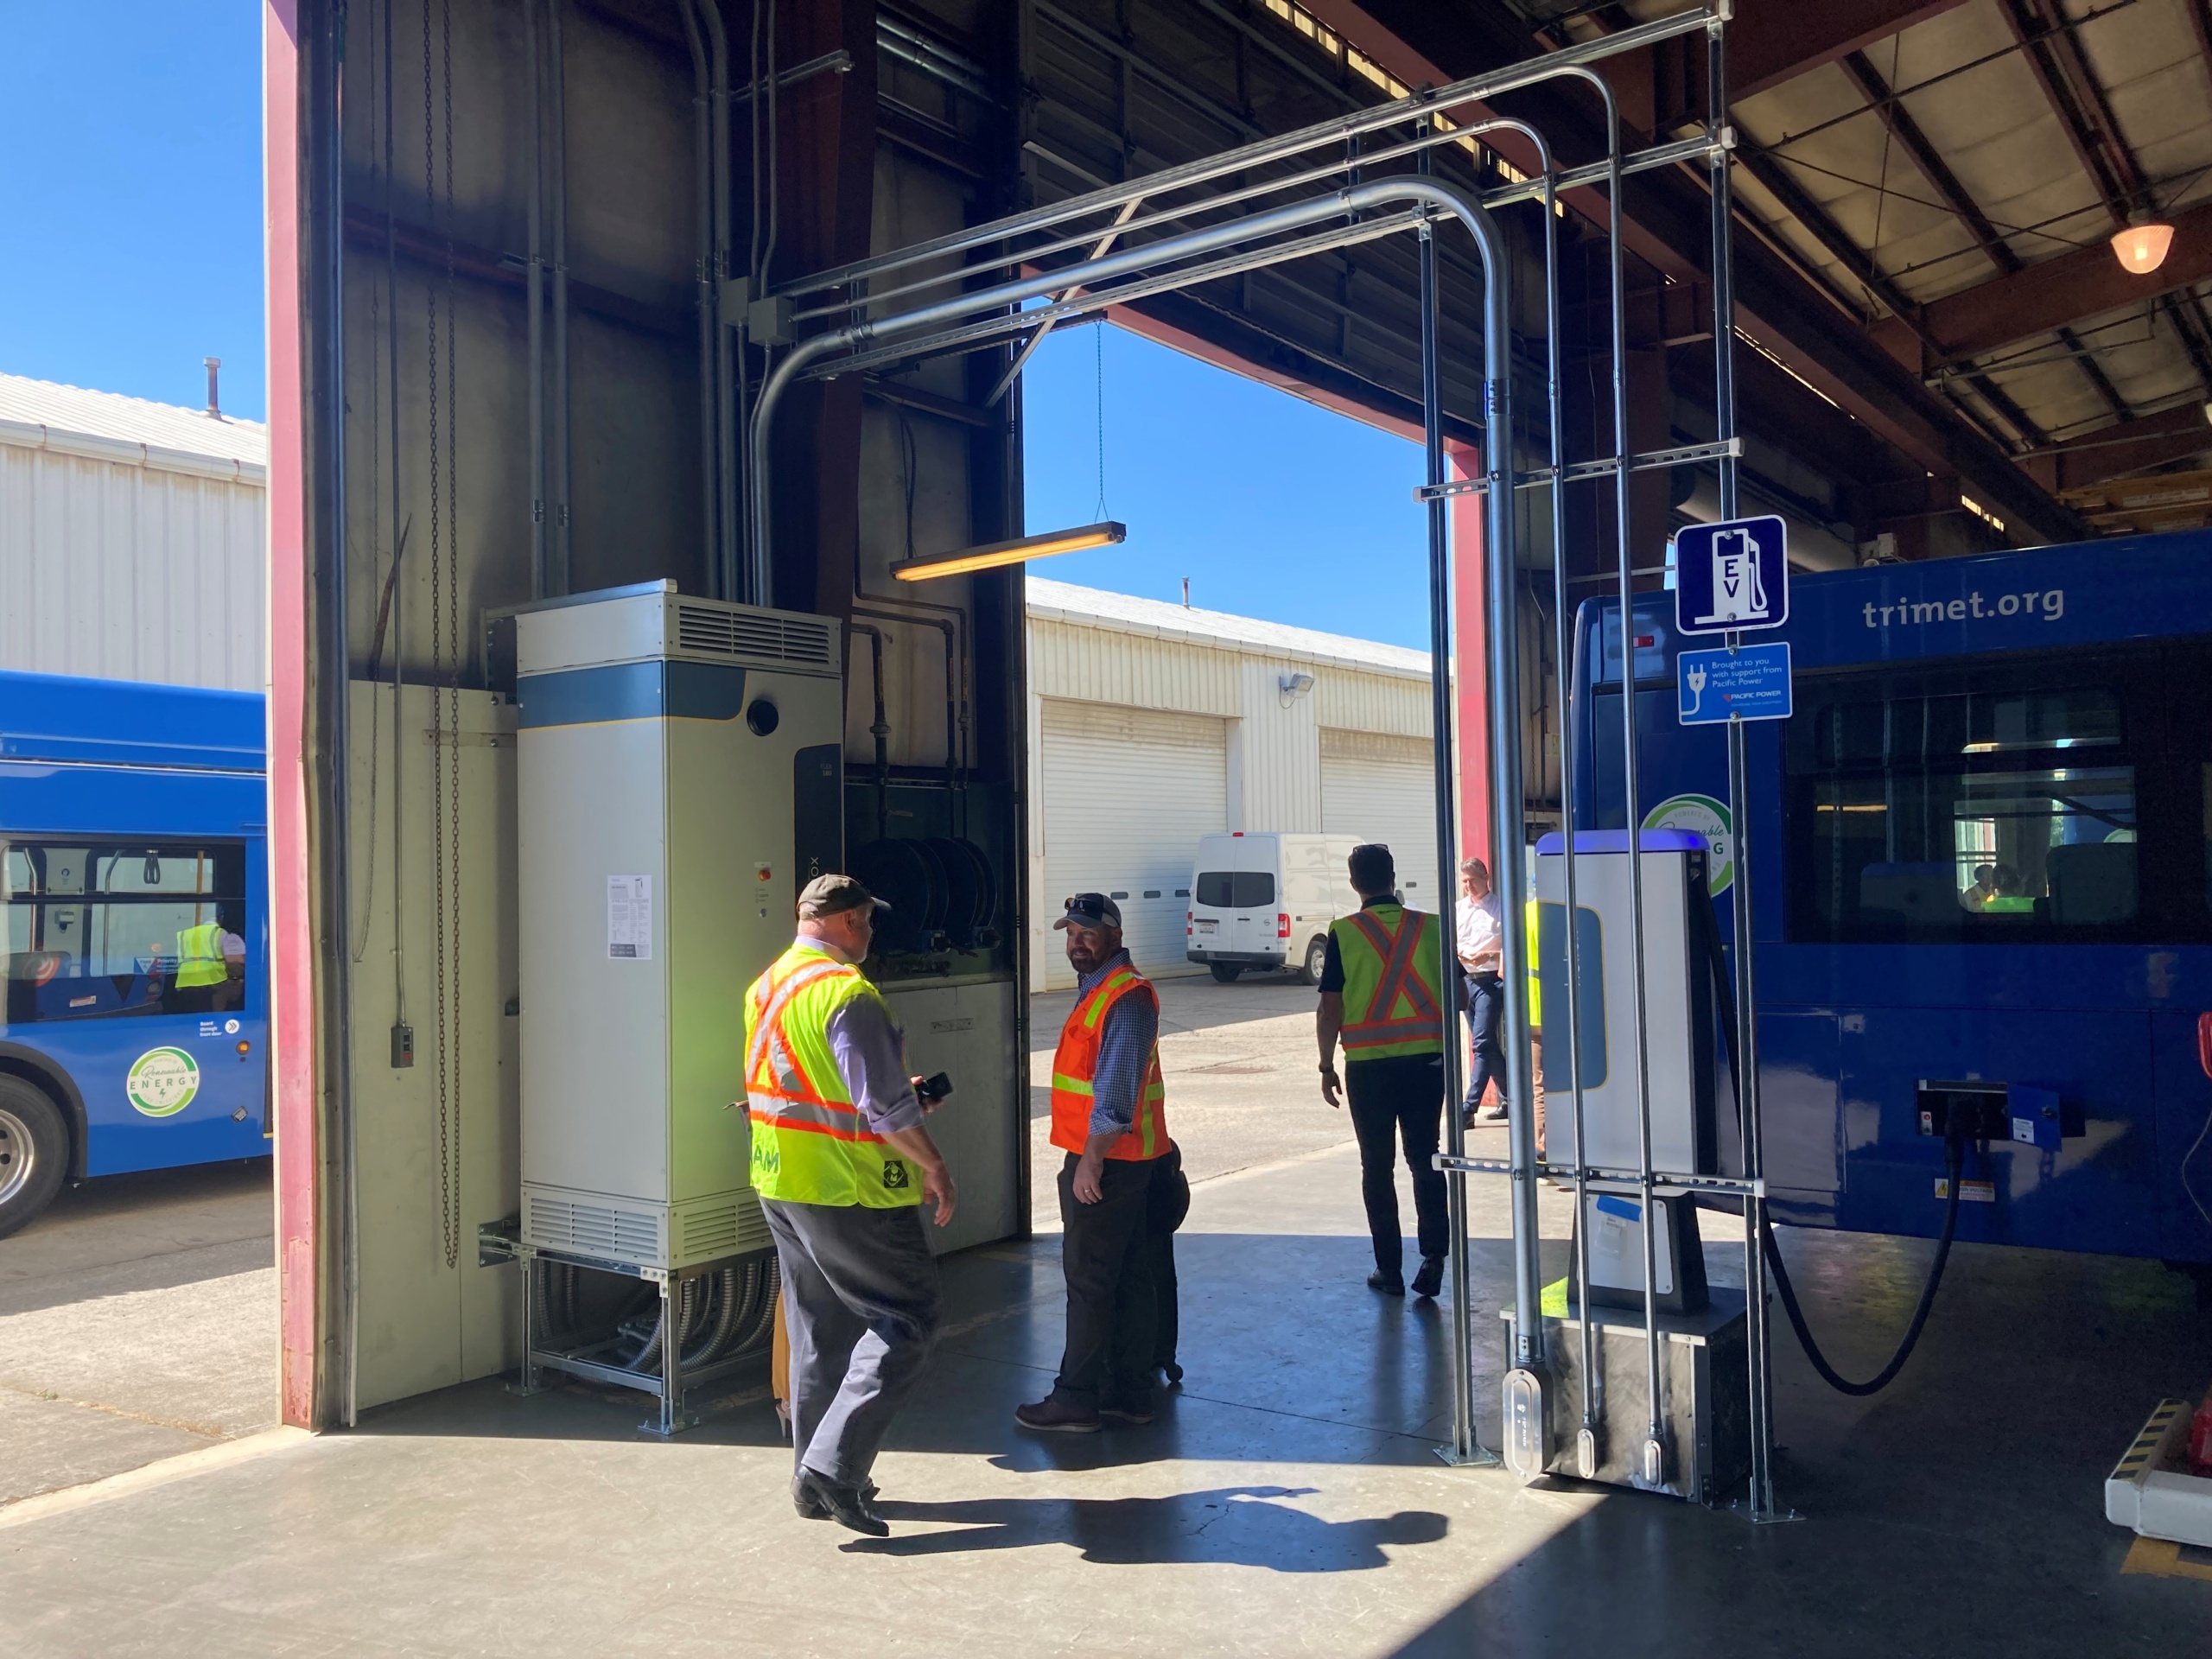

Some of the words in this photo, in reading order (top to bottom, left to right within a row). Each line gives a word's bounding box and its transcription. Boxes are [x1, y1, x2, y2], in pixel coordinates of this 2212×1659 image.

[1723, 558, 1740, 598] EV
[1862, 589, 2063, 628] trimet.org
[1712, 660, 1742, 670] Brought
[1755, 658, 1770, 667] you
[1731, 669, 1761, 677] support
[1712, 679, 1737, 688] Pacific
[1675, 810, 1701, 818] POWERED
[141, 1065, 187, 1080] Renewable
[130, 1076, 197, 1090] ENERGY
